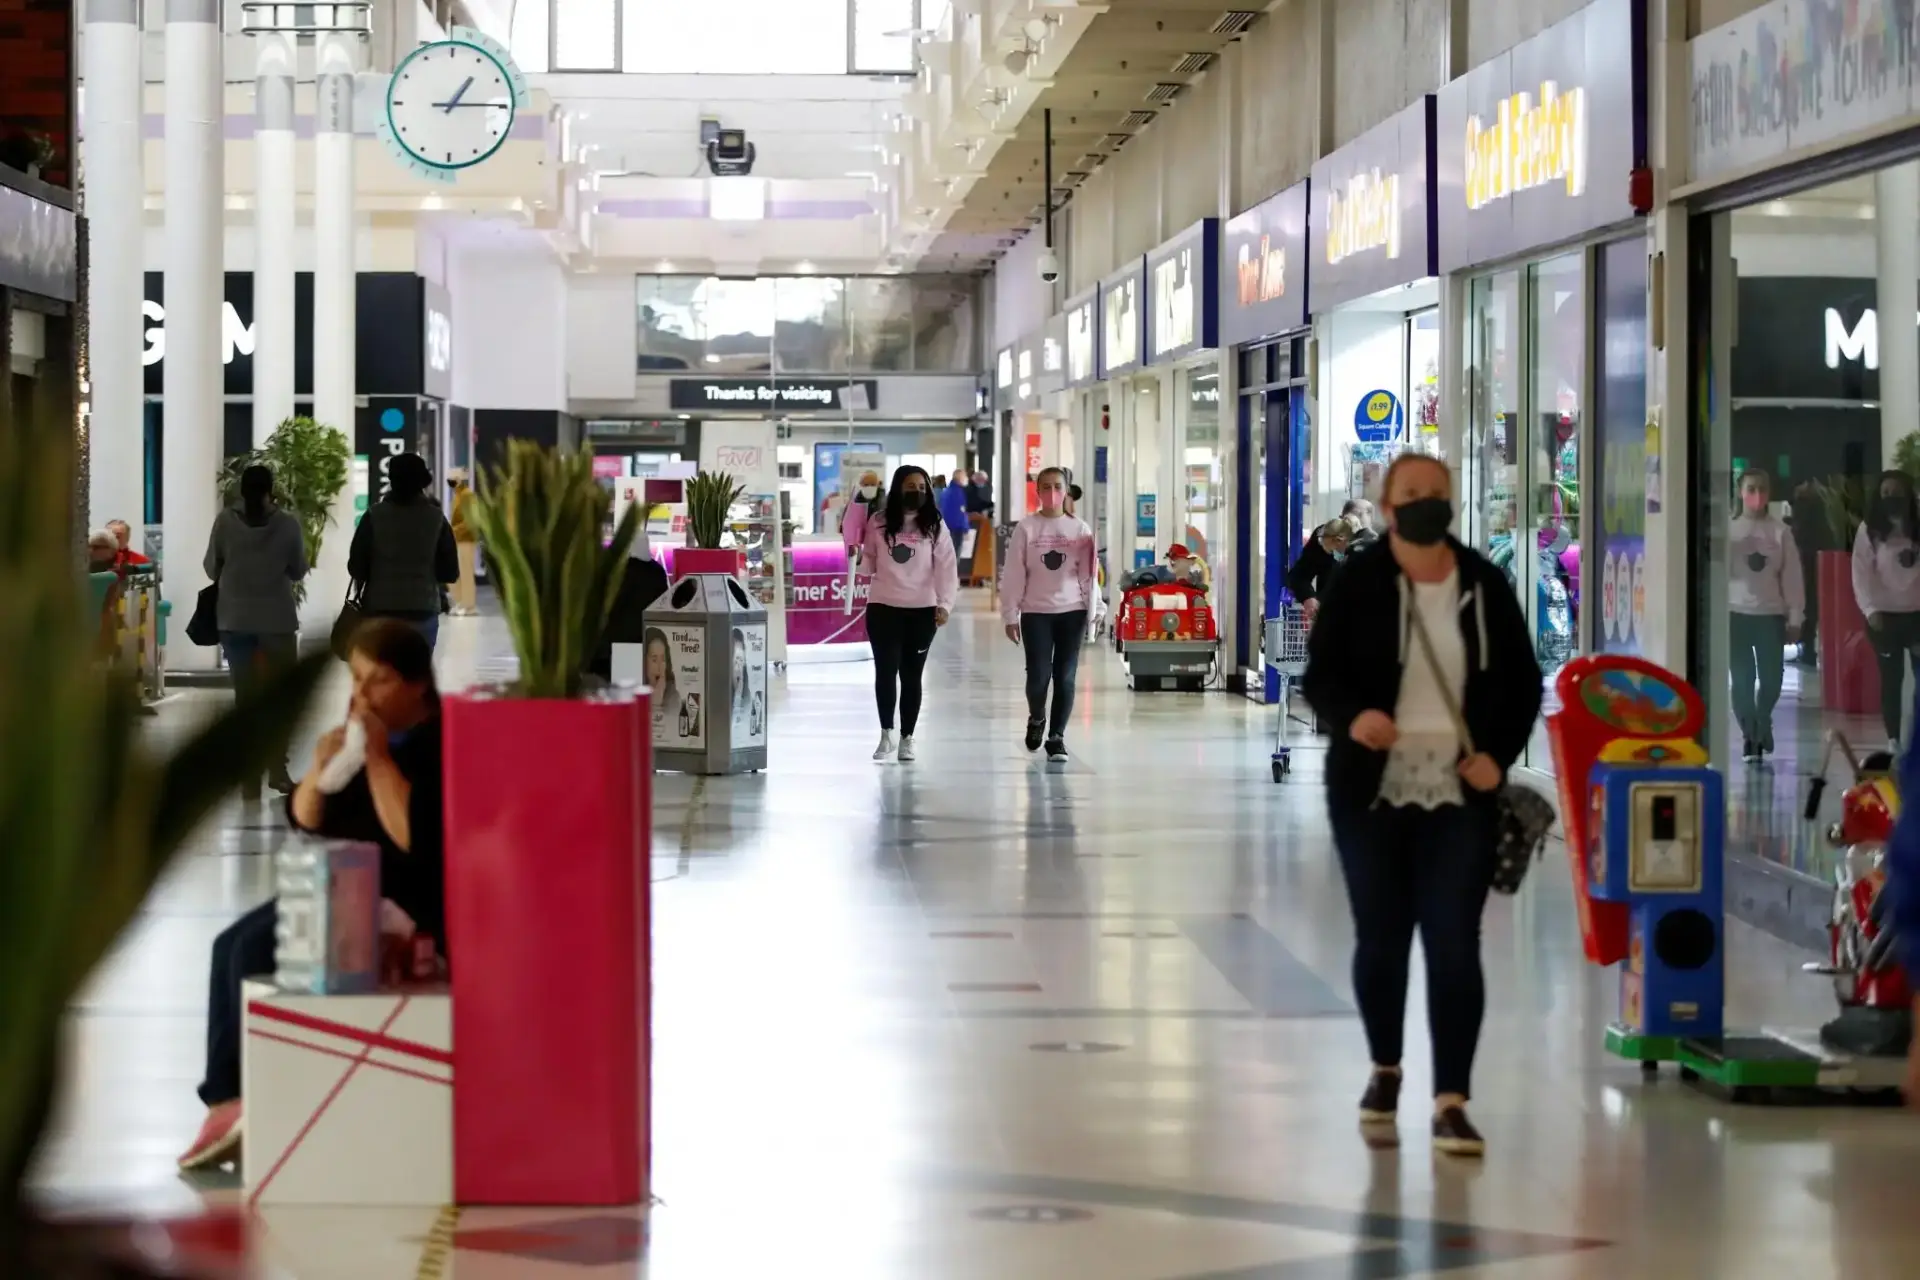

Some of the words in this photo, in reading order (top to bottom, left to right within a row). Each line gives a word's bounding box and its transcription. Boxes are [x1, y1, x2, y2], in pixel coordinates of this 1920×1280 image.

[703, 385, 755, 400] Thanks
[757, 385, 779, 400] for
[781, 385, 832, 404] visiting
[792, 583, 829, 601] mer
